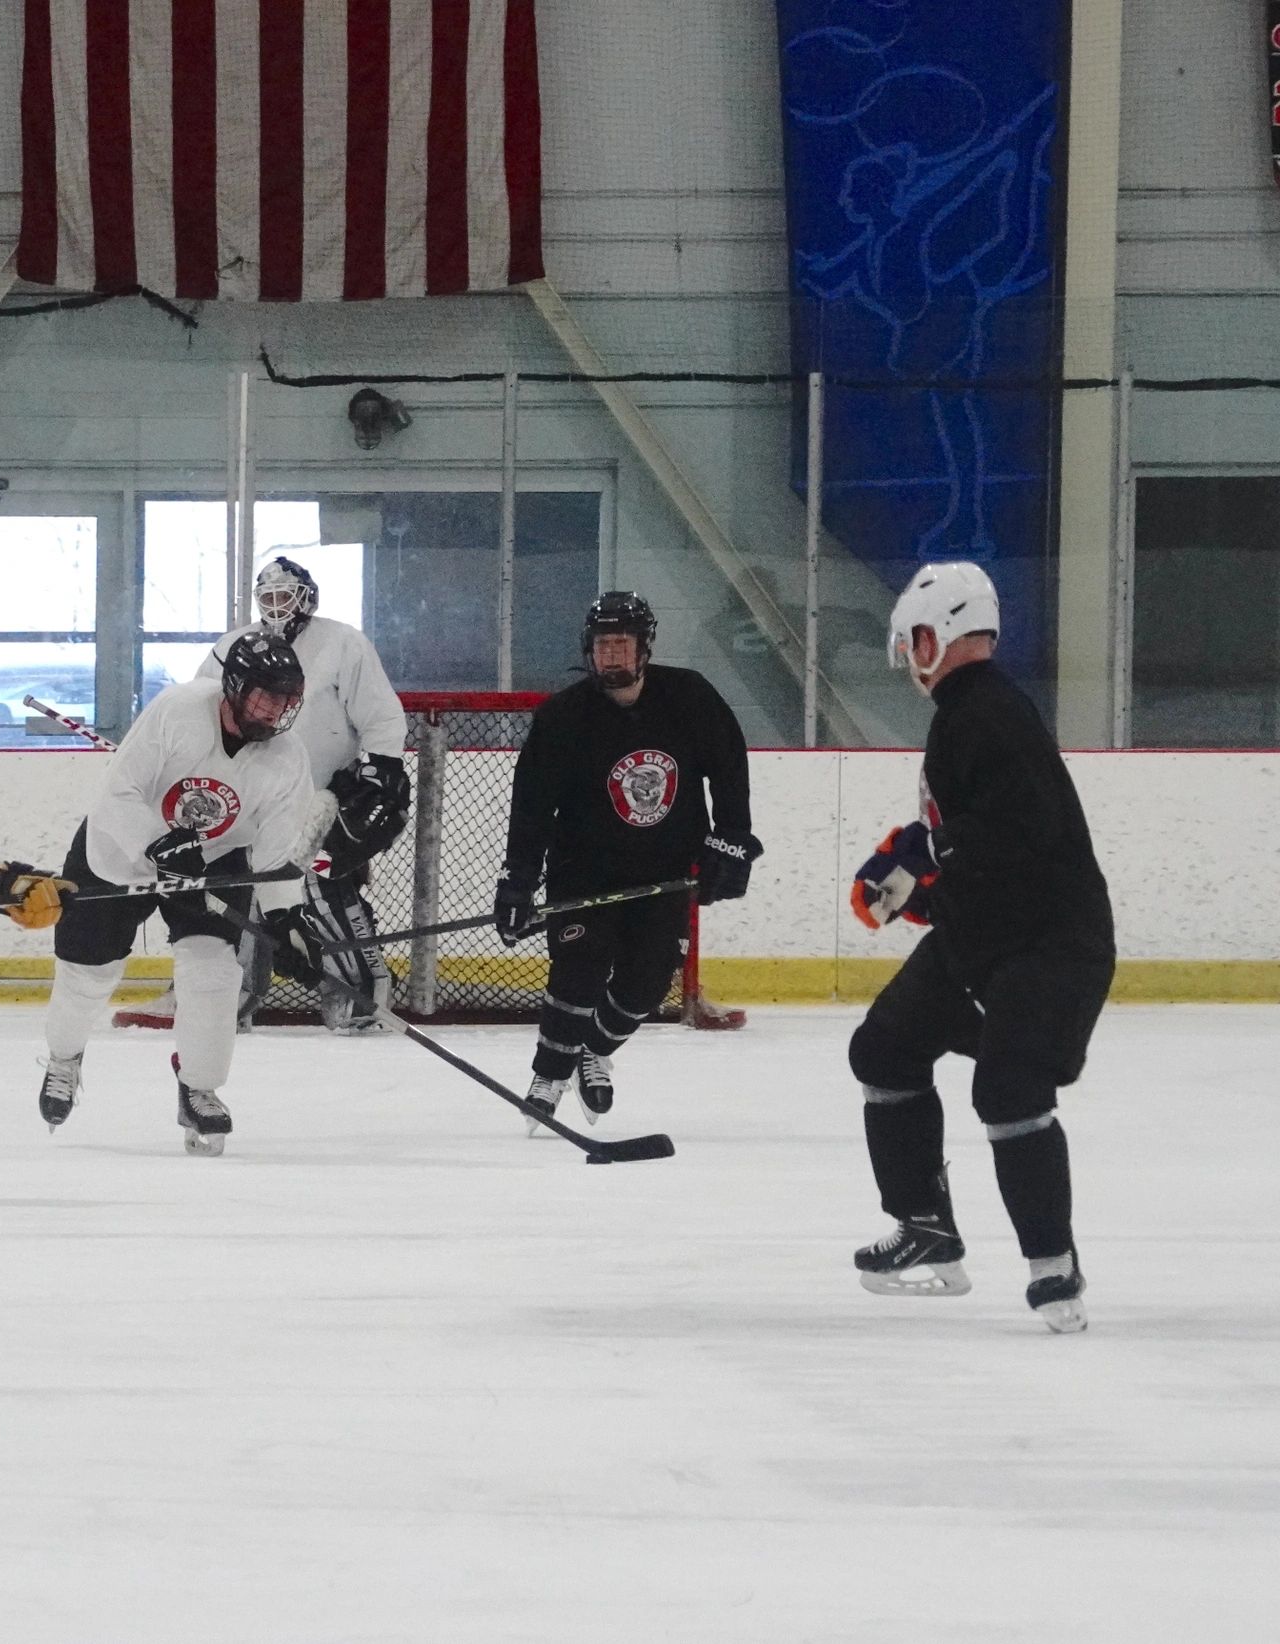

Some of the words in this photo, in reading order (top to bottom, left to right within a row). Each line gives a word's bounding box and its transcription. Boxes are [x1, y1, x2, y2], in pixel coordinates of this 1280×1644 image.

[612, 757, 636, 780] OLD
[182, 780, 210, 790] OLD
[217, 785, 240, 814] GRAY
[628, 803, 668, 824] PUCKS
[704, 833, 747, 860] eebok
[128, 877, 207, 896] CCM
